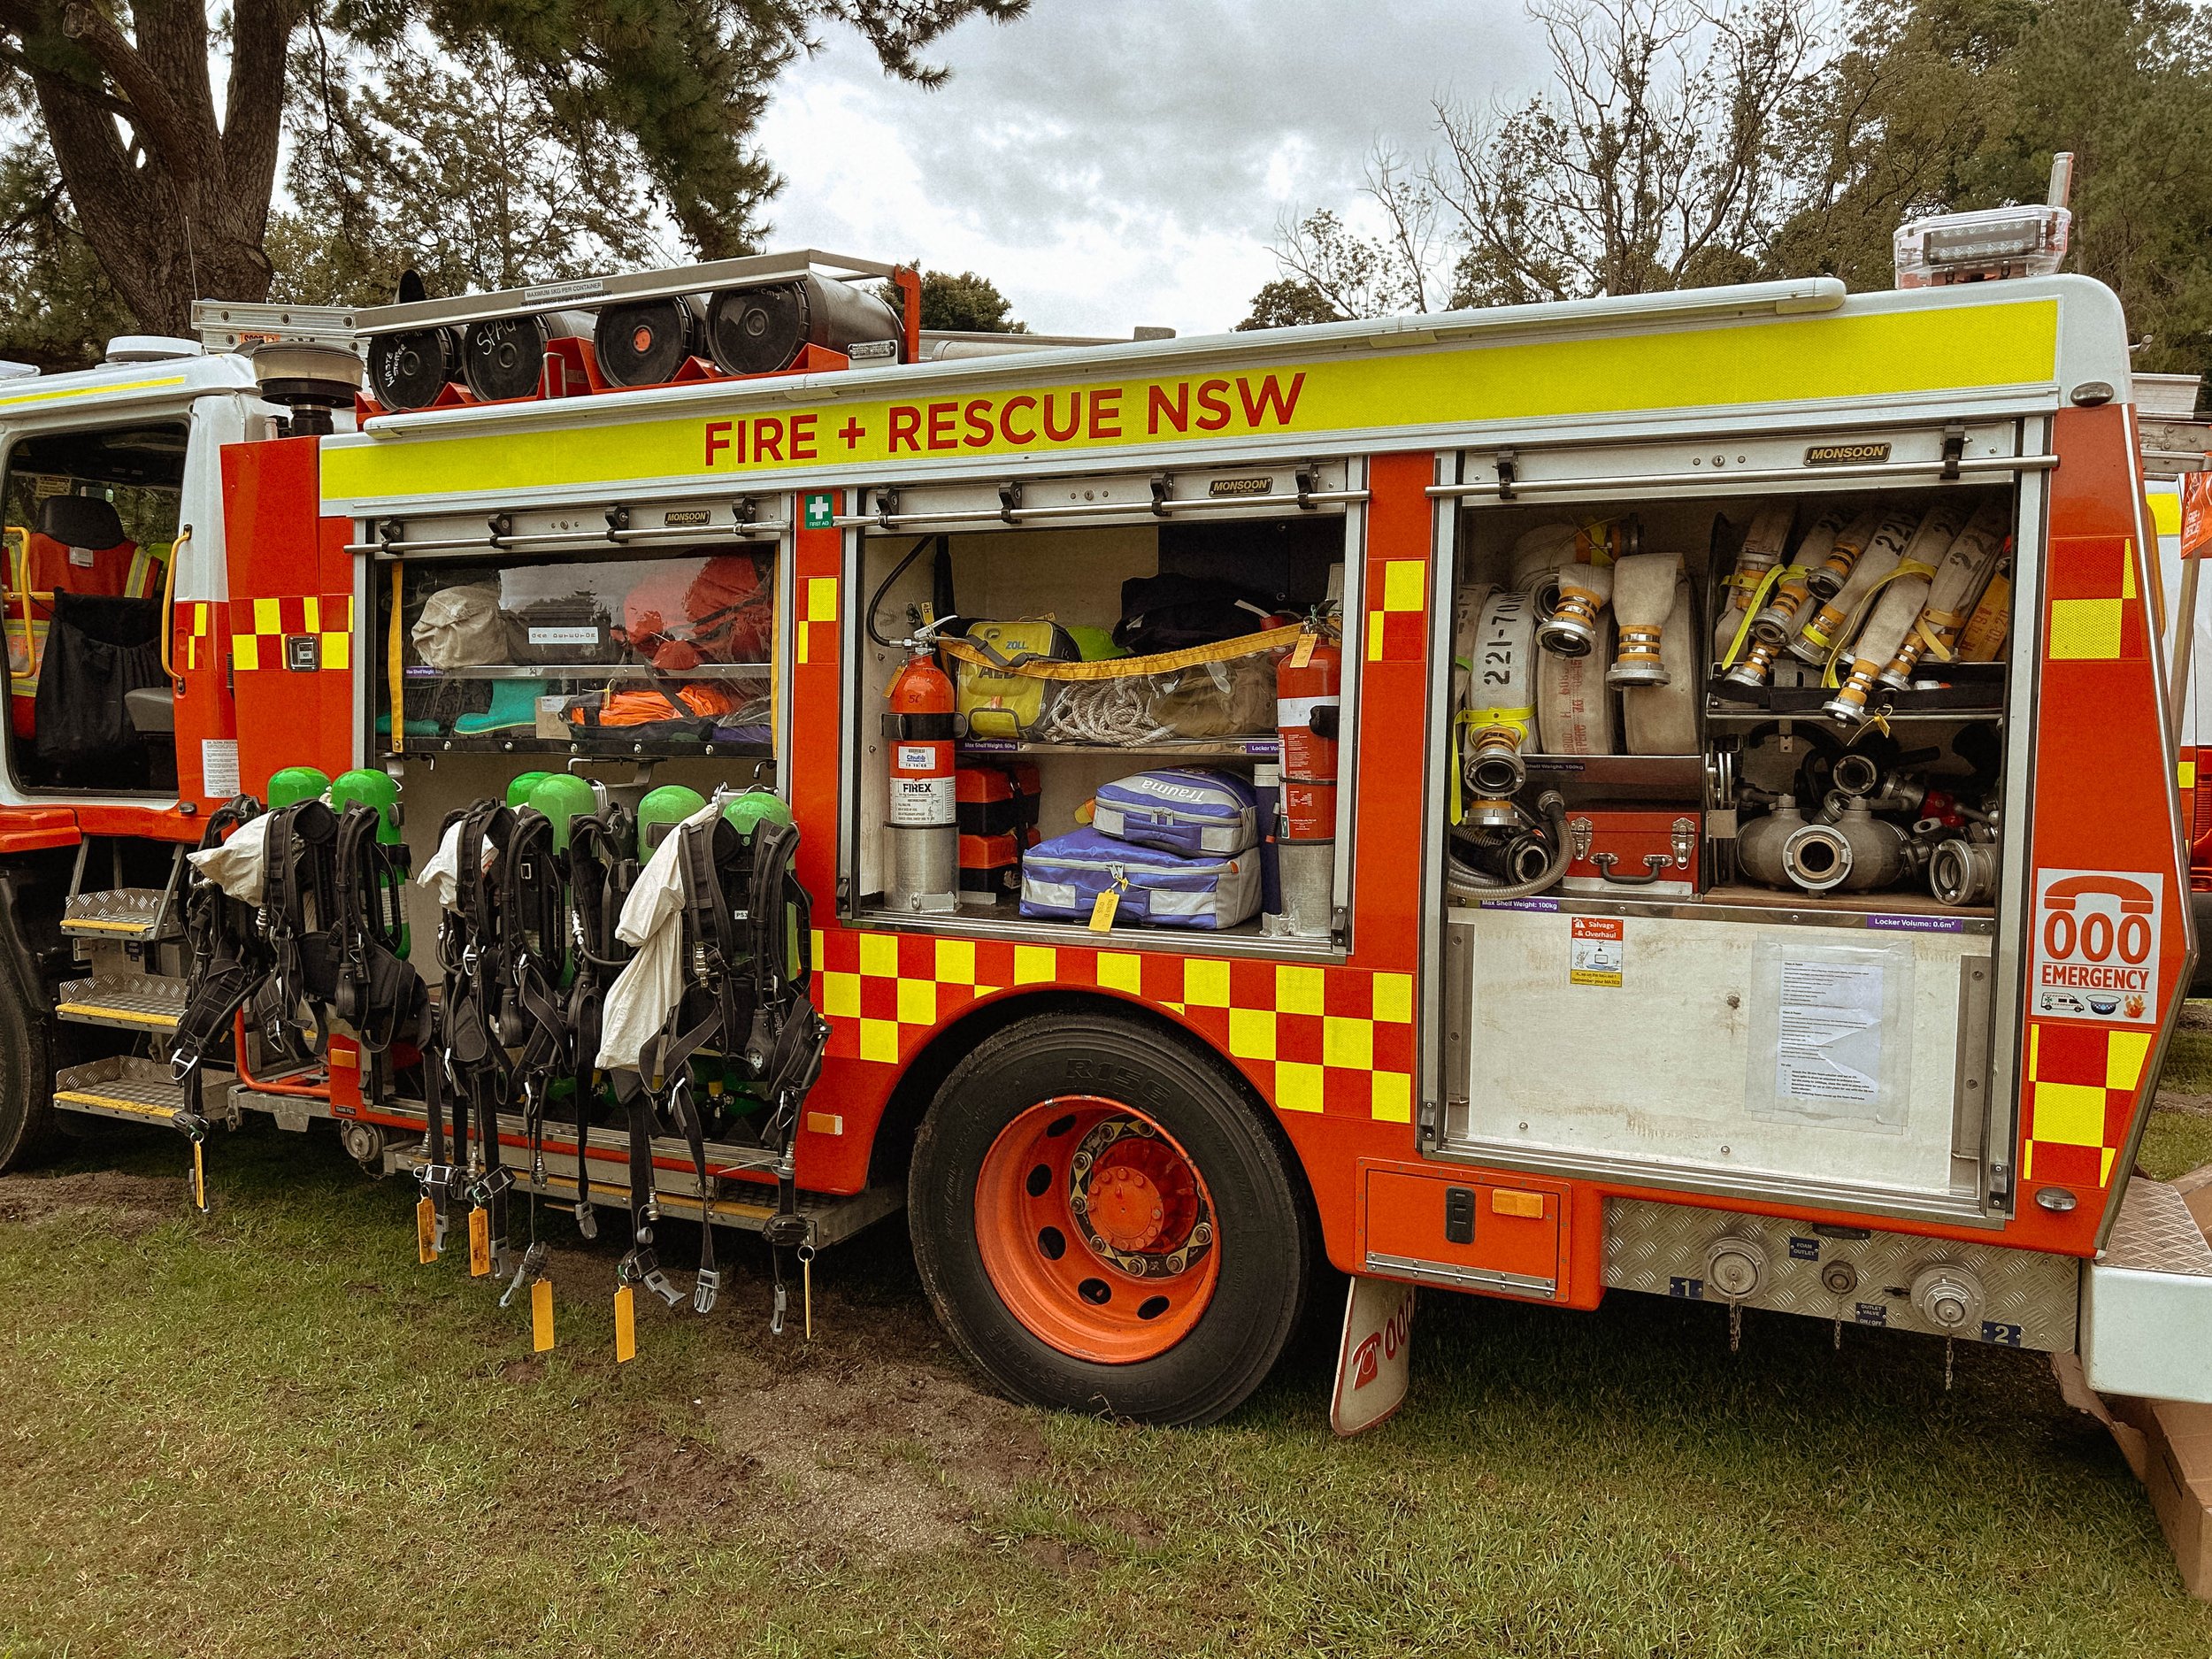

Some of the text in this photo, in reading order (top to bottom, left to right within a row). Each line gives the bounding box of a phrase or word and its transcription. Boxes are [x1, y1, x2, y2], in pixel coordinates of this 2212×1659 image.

[526, 289, 550, 298] MAXIMUM
[572, 282, 602, 293] CONTAINER
[385, 351, 396, 388] WASTE
[705, 373, 1307, 466] FIRE + RESCUE NSW
[1810, 445, 1886, 460] MONSOON
[1213, 480, 1268, 492] MONSOON
[666, 511, 707, 522] MONSOON
[1005, 640, 1028, 650] ZOLL
[902, 783, 932, 793] FIREX
[1141, 779, 1205, 803] Trauma
[1513, 901, 1538, 910] Weight:
[1539, 902, 1558, 910] 100kg
[1588, 921, 1615, 930] Salvage
[1874, 918, 1901, 926] Locker
[1901, 919, 1932, 928] Volume:
[1585, 930, 1617, 939] Overhaul
[2043, 910, 2153, 965] 000
[2041, 964, 2150, 991] EMERGENCY
[1680, 1279, 1691, 1297] 1
[1993, 1325, 2010, 1345] 2
